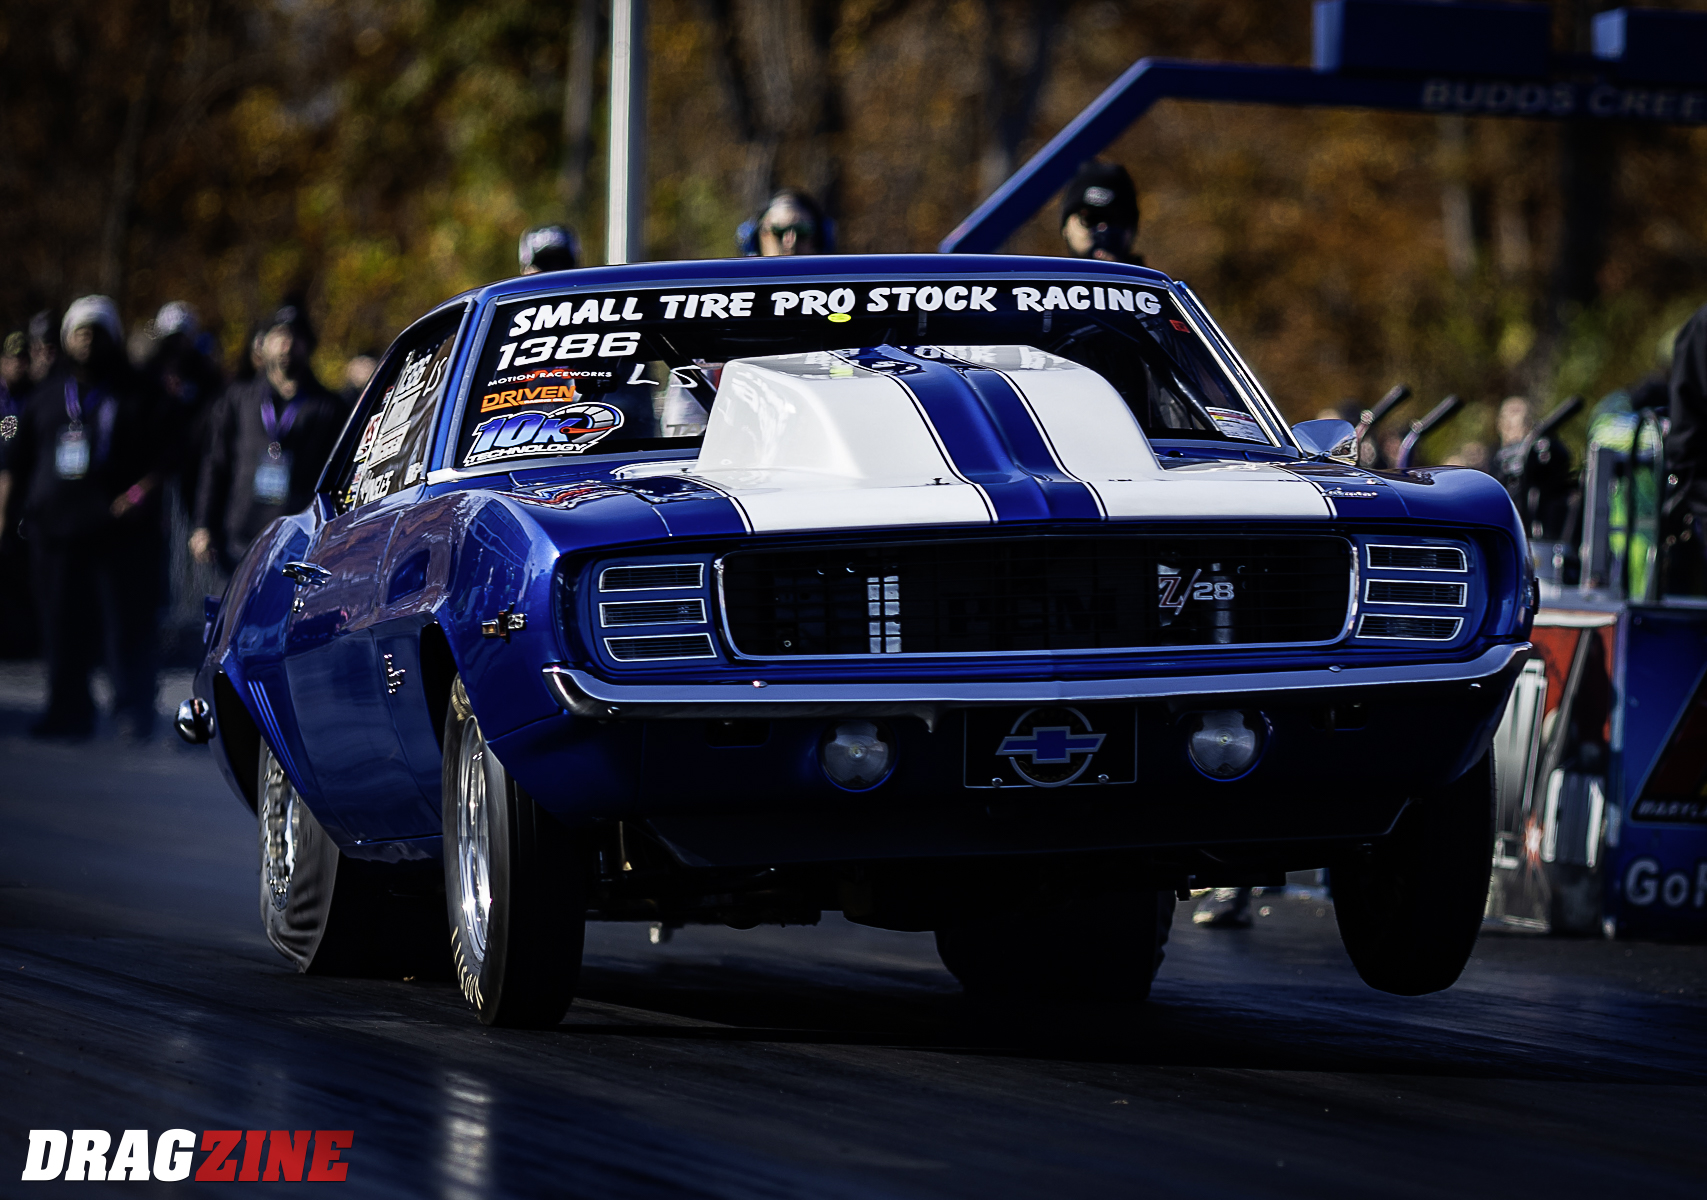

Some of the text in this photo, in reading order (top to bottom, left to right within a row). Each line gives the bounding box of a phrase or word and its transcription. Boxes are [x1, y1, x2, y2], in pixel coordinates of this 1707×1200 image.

[1421, 79, 1578, 115] BUDDS
[508, 285, 1162, 337] SMALL TIRE PRO STOCK RACING
[497, 332, 641, 370] 1386
[487, 371, 613, 387] MOTION RACEWORKS
[481, 386, 576, 411] DRIVEN
[468, 443, 588, 463] TECHNOLOGY
